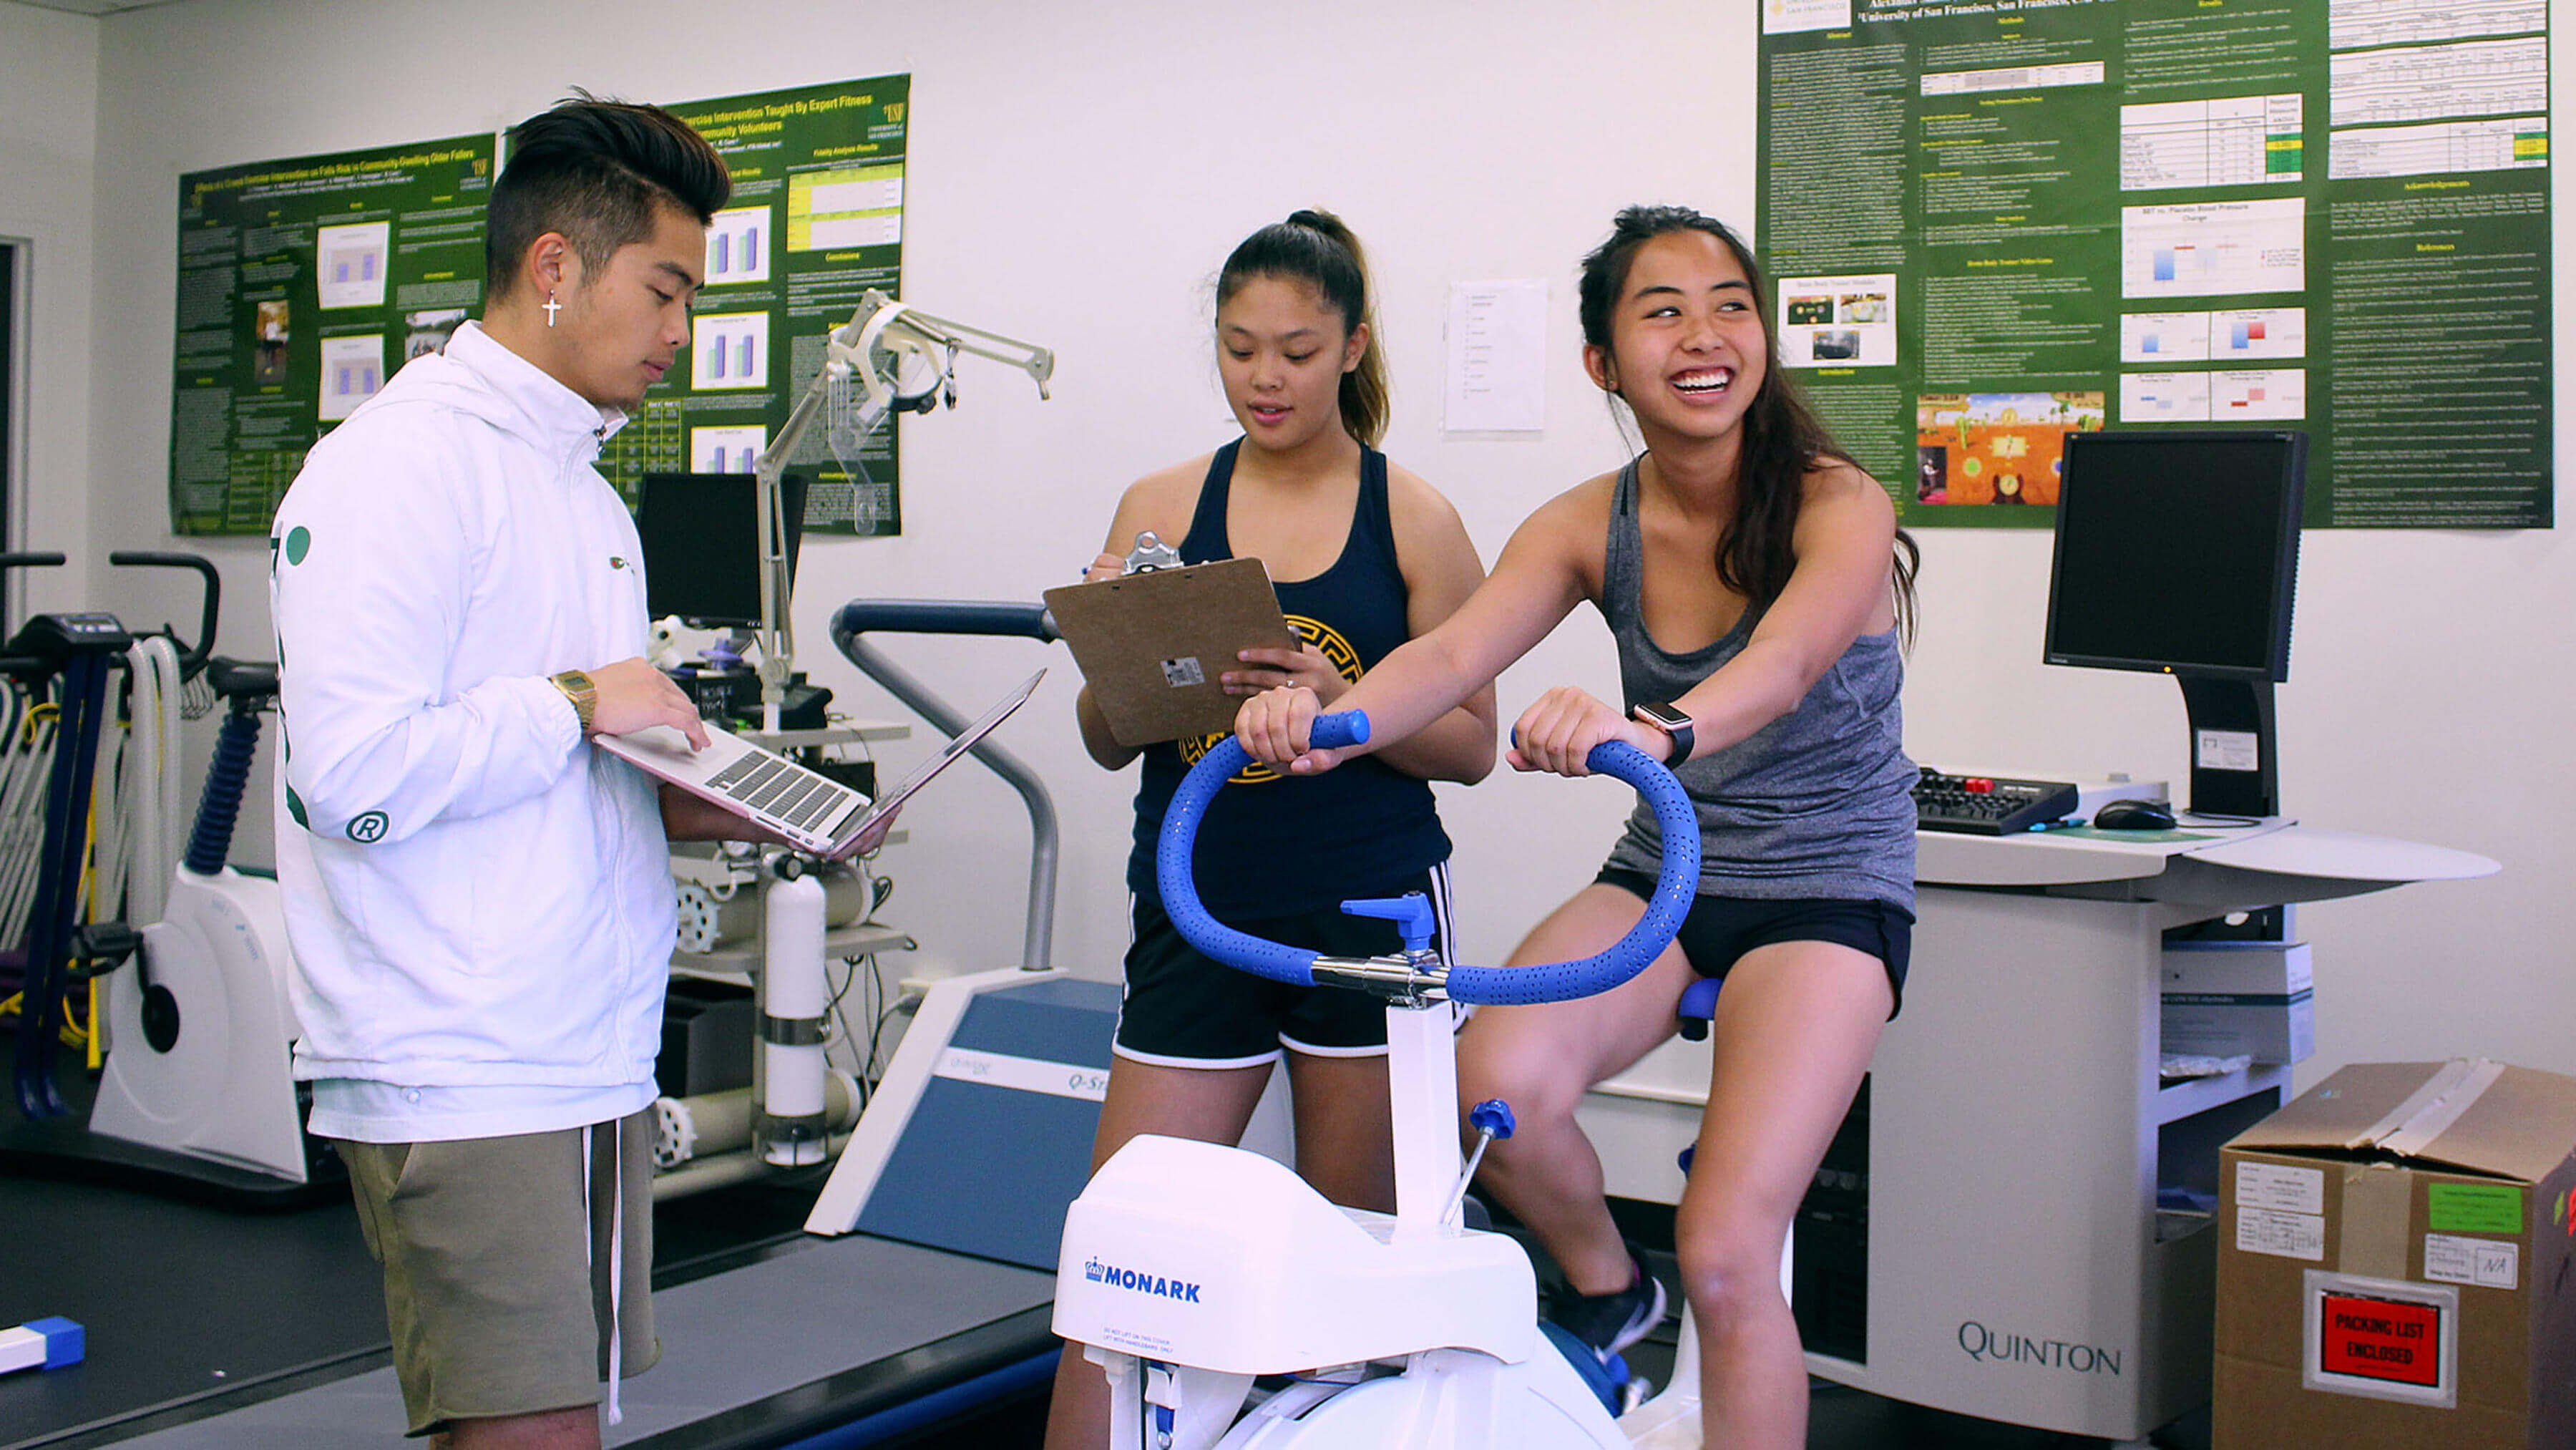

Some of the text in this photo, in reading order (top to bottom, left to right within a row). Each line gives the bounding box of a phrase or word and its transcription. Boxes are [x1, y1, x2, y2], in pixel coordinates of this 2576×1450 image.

[1923, 7, 1943, 17] San
[714, 109, 763, 122] Intervention
[765, 105, 794, 119] Taught
[795, 101, 807, 115] By
[809, 97, 839, 113] Expert
[839, 94, 873, 107] Fitness
[738, 120, 783, 135] Volunteers
[1104, 1266, 1201, 1304] MONARK
[2336, 1313, 2424, 1340] PACKING LIST
[1958, 1321, 2122, 1376] QUINTON
[2346, 1340, 2414, 1365] ENCLOSED
